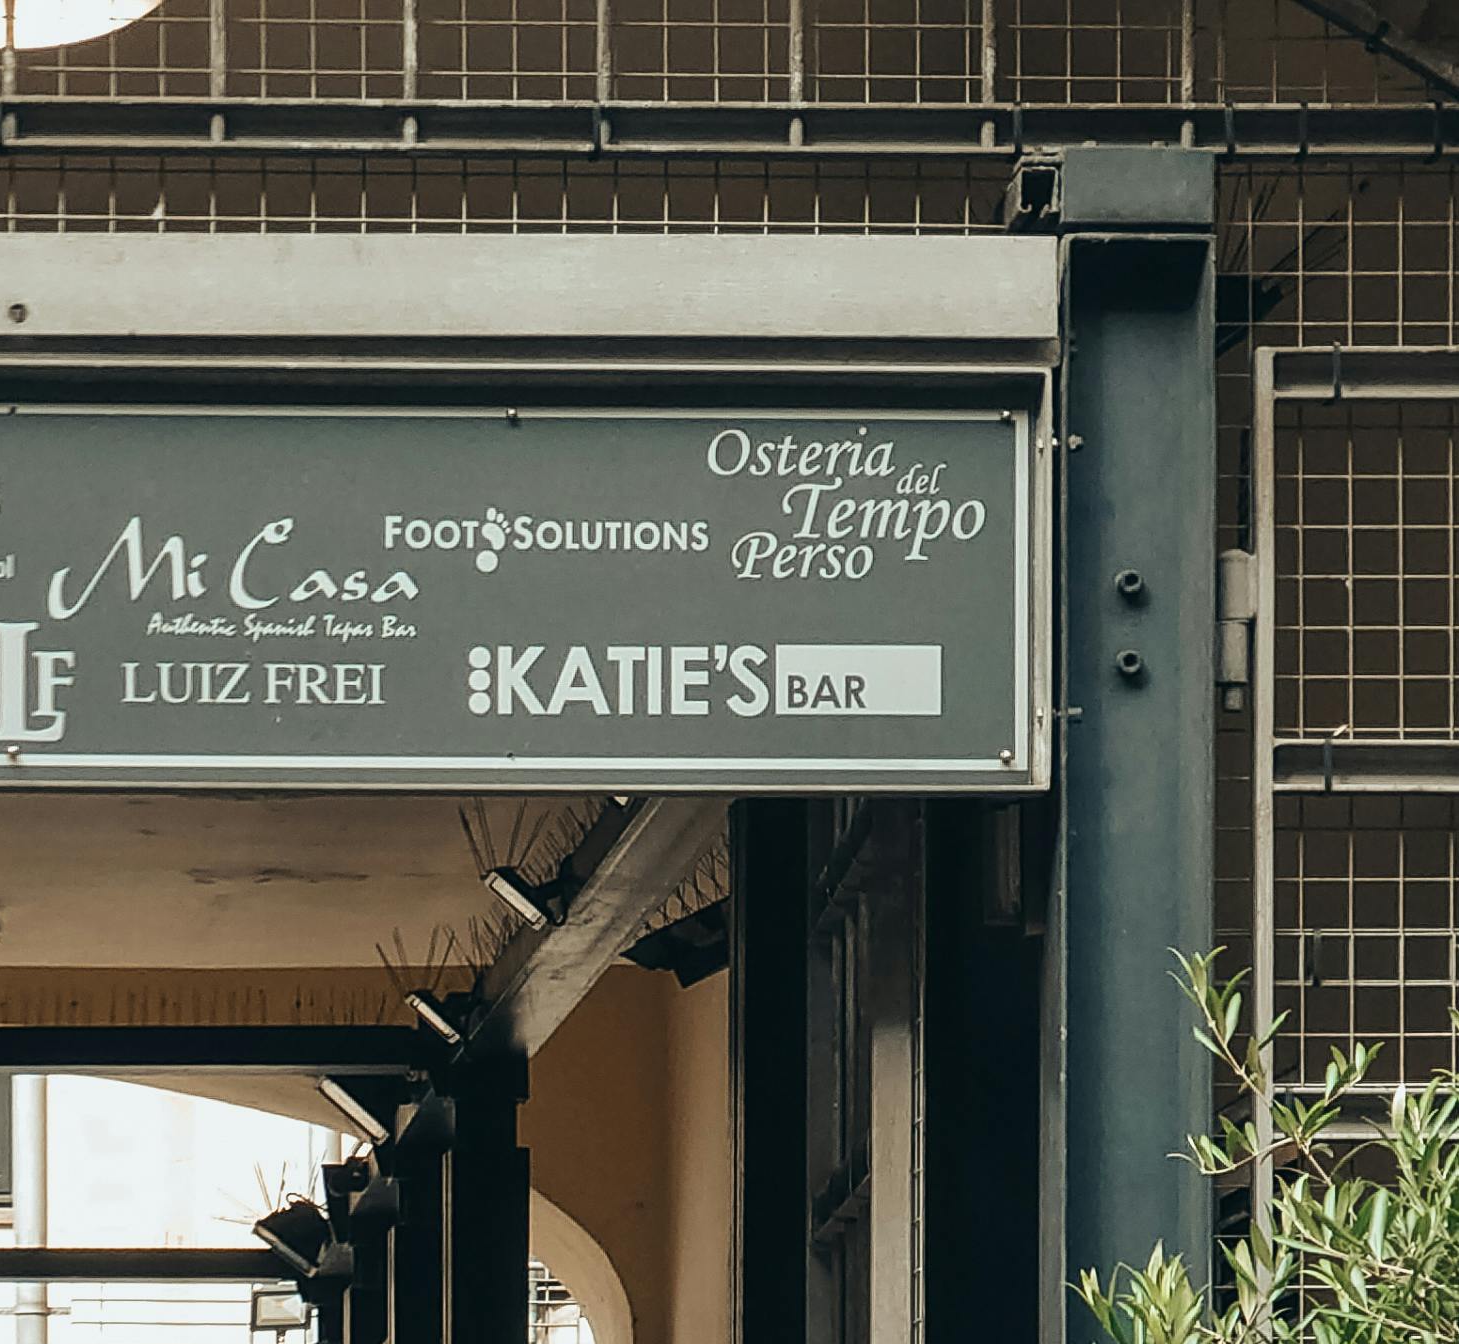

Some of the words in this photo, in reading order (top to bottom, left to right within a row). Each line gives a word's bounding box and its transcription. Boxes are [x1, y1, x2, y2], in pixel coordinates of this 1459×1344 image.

[707, 426, 896, 476] Osteria
[896, 463, 947, 495] del
[512, 515, 709, 551] SOLUTIONS
[782, 477, 986, 561] Tempo
[48, 516, 209, 620] Mi
[229, 517, 420, 610] Casa
[731, 531, 874, 579] Perso
[146, 611, 237, 637] Authentic
[243, 612, 317, 643] Spanish
[322, 614, 374, 643] Tapas
[381, 615, 417, 639] Bar
[121, 662, 251, 704] LUIZ
[263, 663, 387, 705] FREI
[497, 645, 770, 717] KATIE'S
[787, 674, 867, 709] BAR
